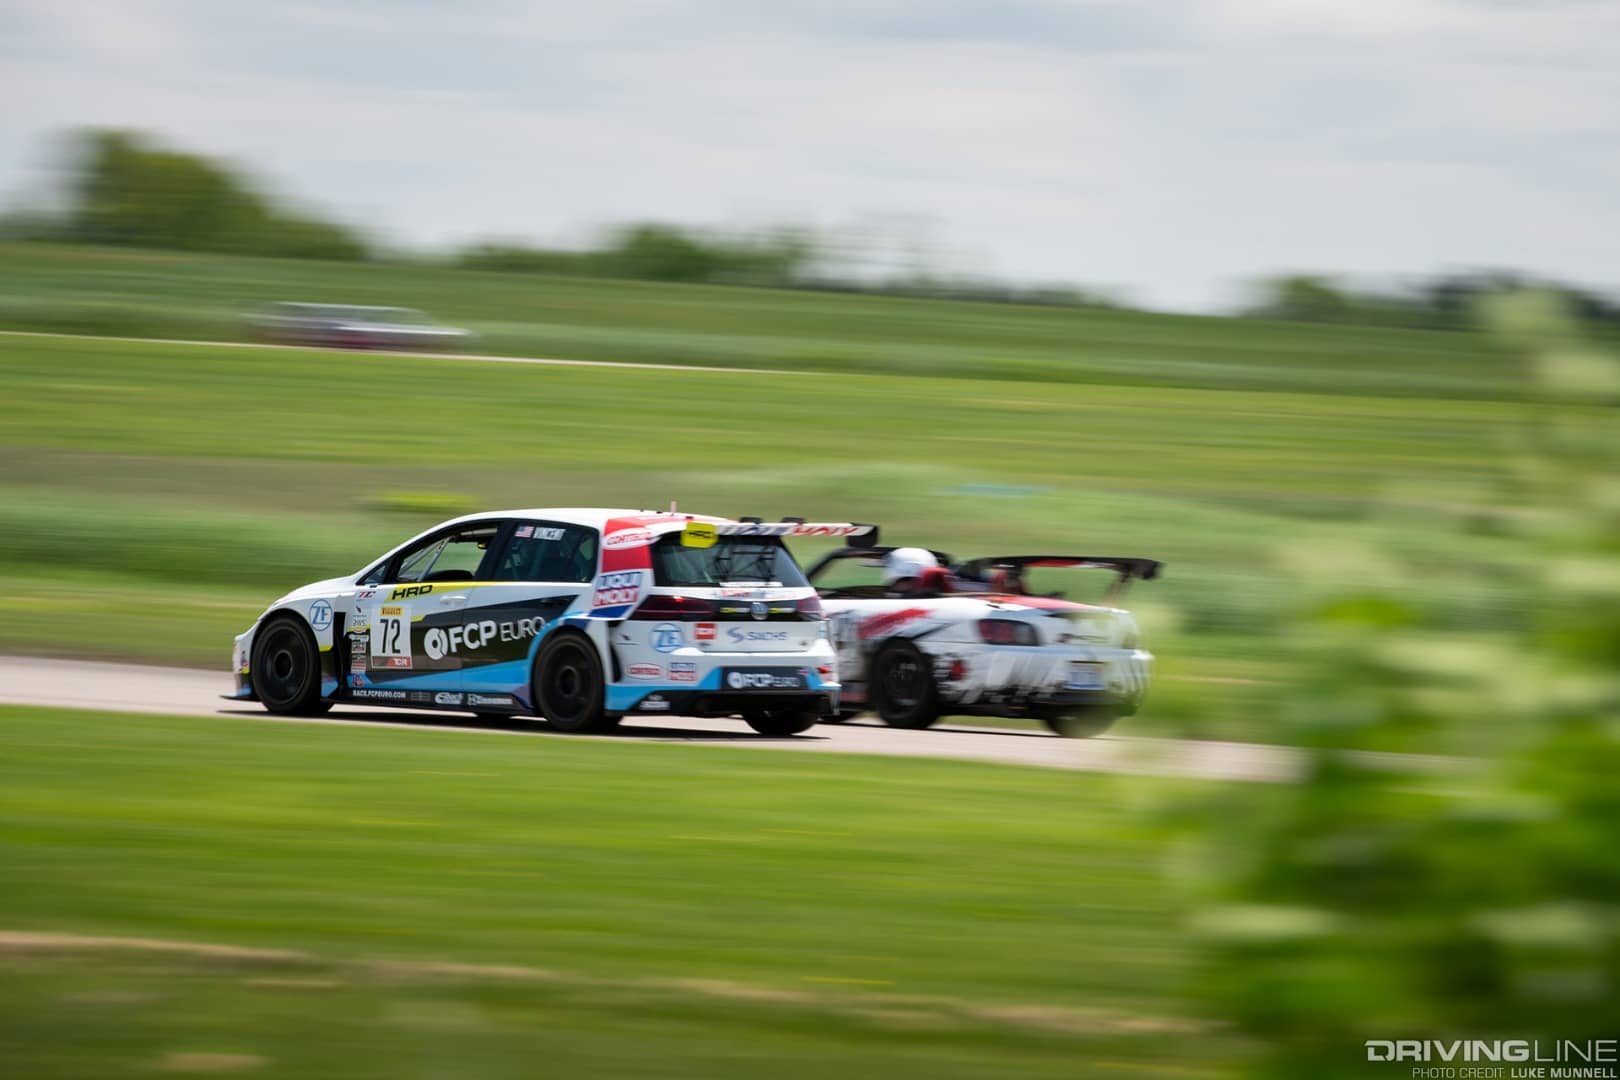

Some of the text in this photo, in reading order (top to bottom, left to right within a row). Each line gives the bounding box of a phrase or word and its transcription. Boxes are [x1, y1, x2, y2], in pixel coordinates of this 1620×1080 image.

[391, 584, 433, 600] HRD
[311, 605, 330, 626] ZF
[379, 618, 401, 654] 72
[447, 616, 547, 654] FCP EURO
